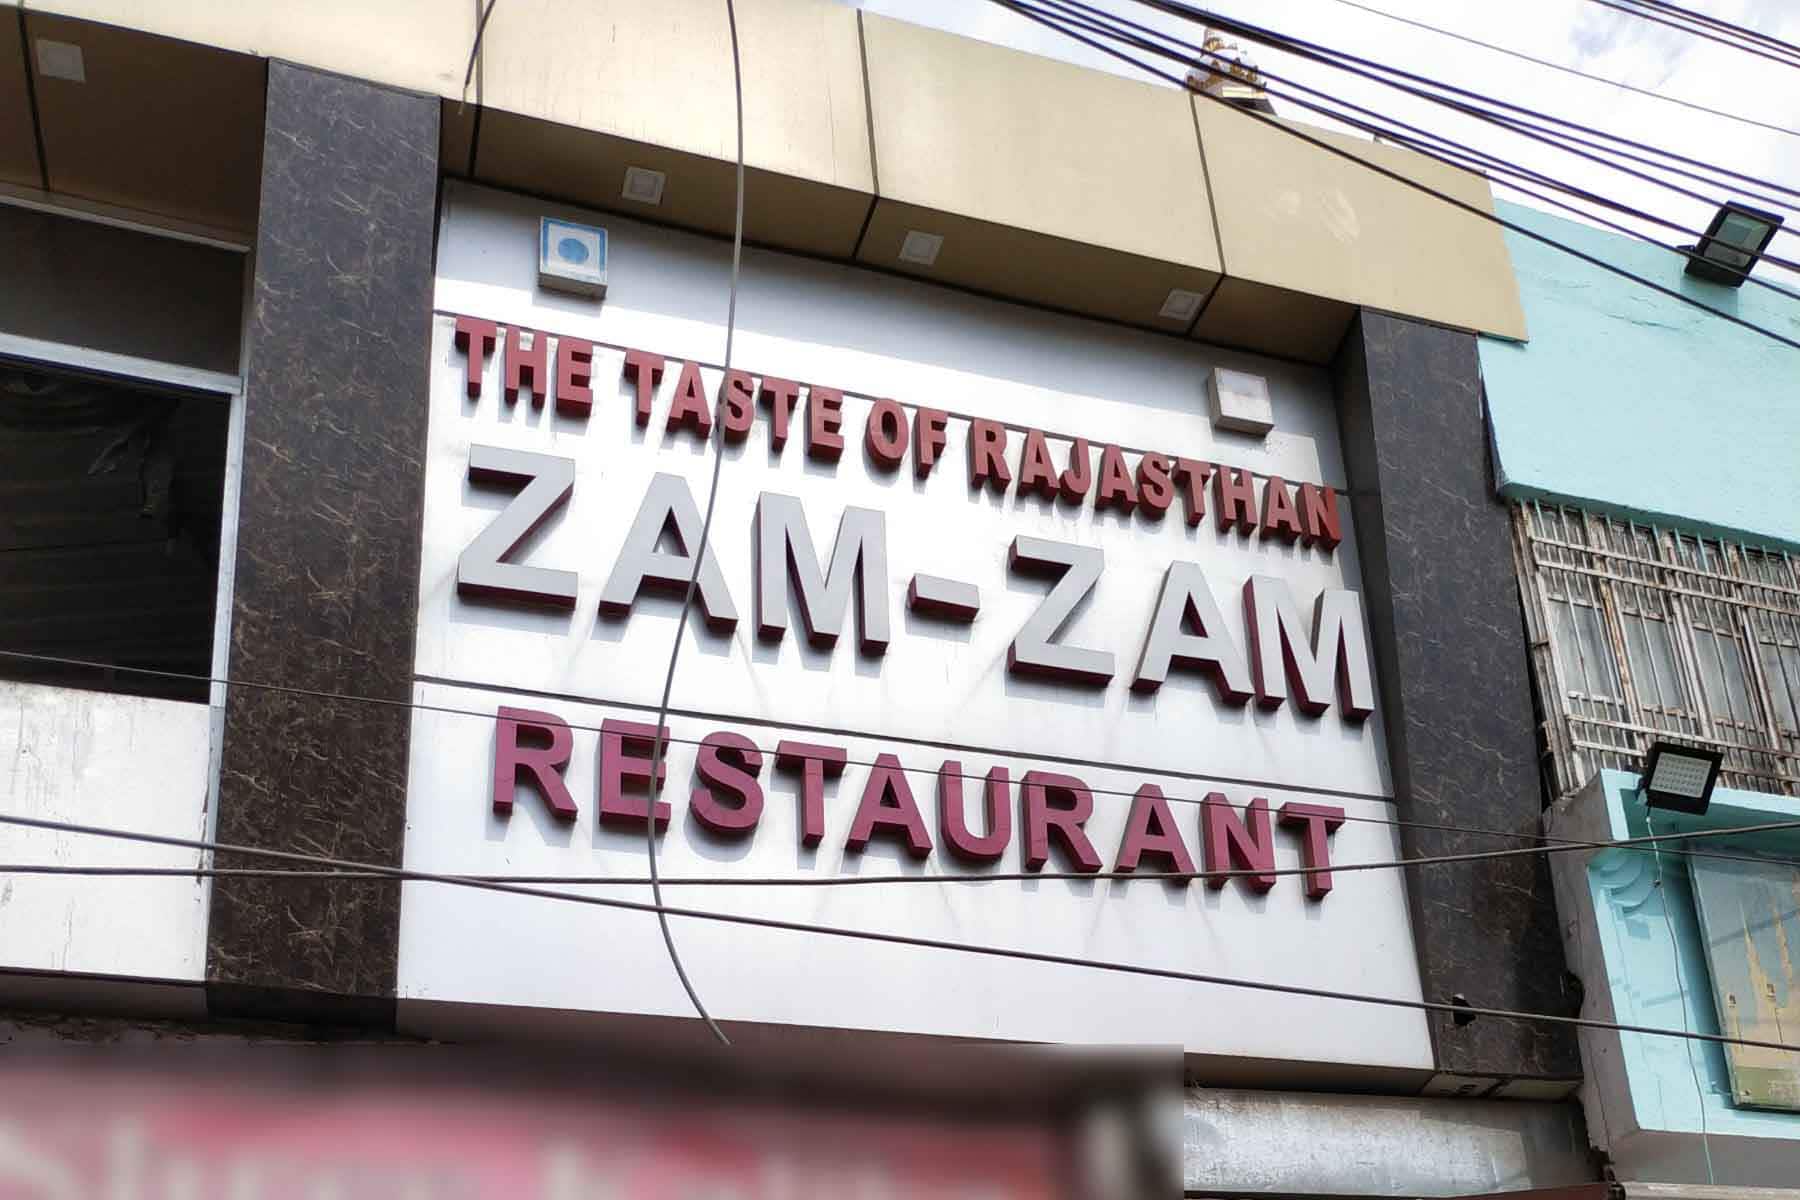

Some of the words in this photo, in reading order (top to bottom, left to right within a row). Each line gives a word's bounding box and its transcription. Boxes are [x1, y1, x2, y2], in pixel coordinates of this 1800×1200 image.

[455, 315, 593, 417] THE
[624, 350, 843, 462] TASTE
[866, 398, 948, 478] OF
[969, 417, 1341, 550] RAJASTHAN
[457, 443, 1374, 722] ZAM-ZAM
[493, 705, 1346, 900] RESTAURANT
